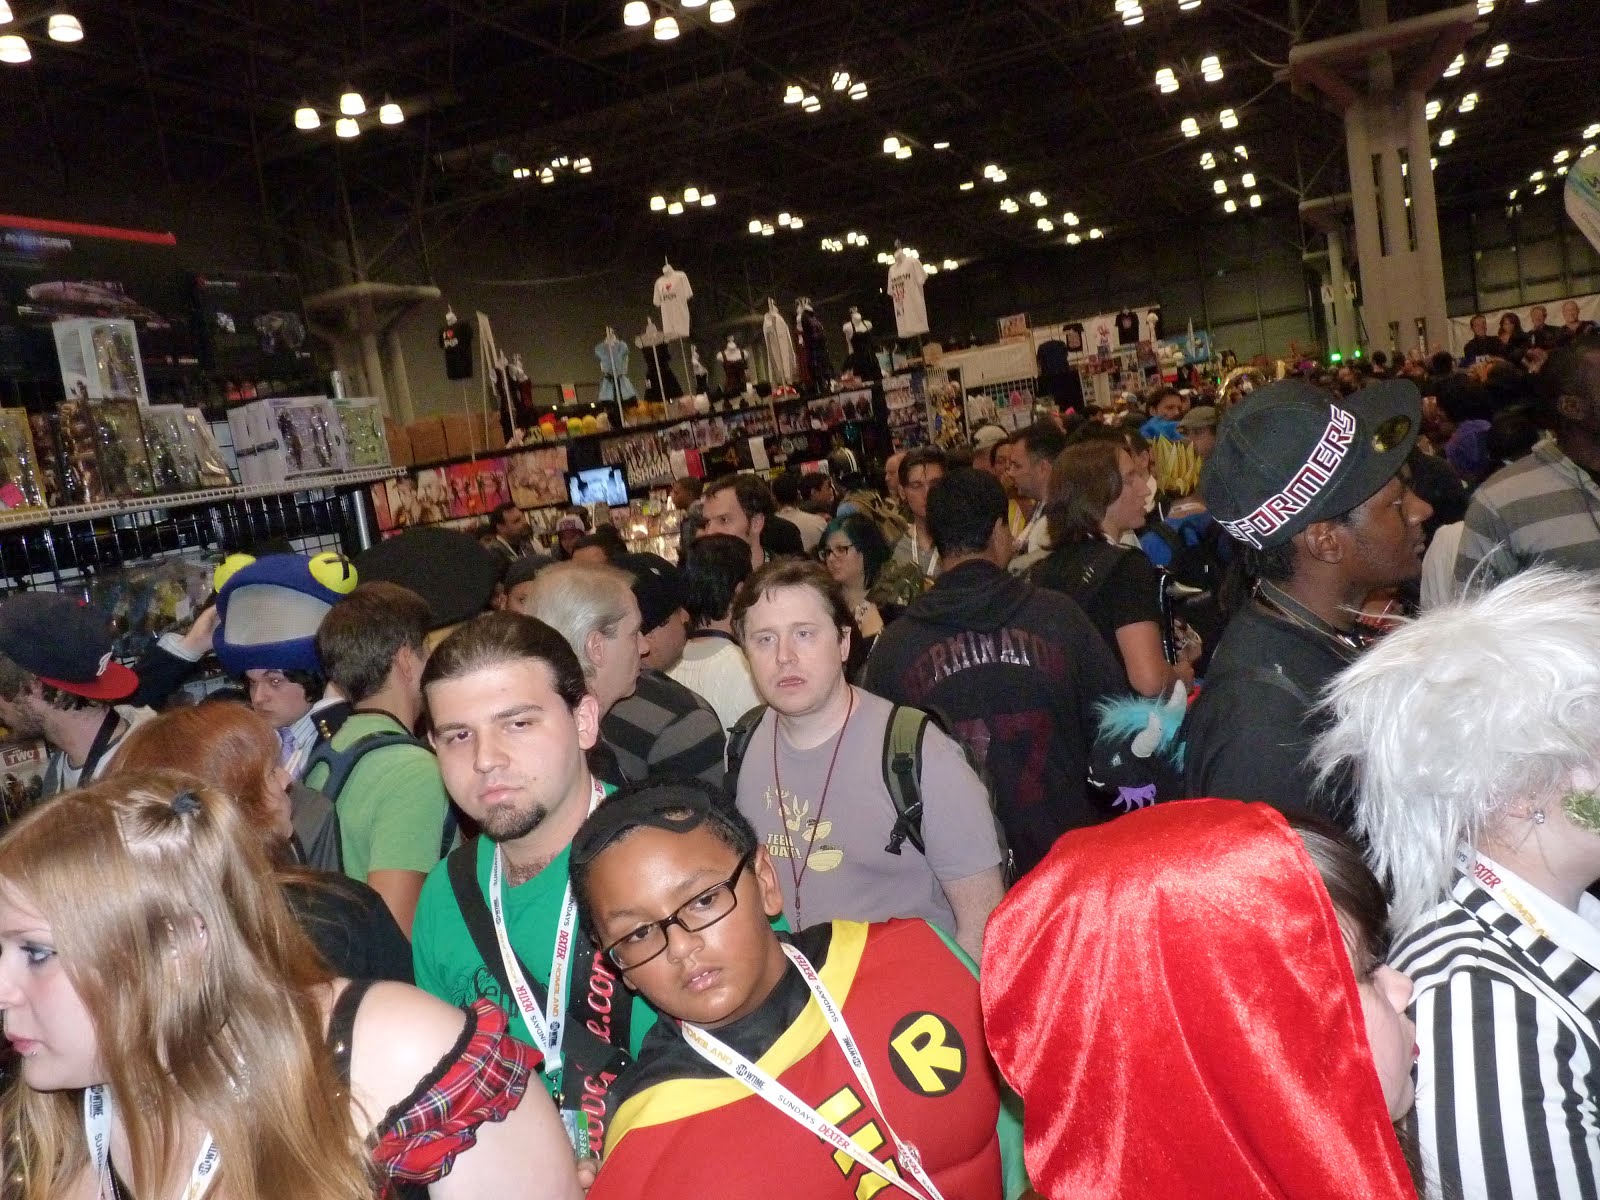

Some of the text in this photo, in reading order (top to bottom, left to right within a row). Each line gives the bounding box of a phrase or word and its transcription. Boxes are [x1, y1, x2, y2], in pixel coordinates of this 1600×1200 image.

[8, 749, 34, 764] TWO
[767, 833, 794, 847] TEEN
[767, 844, 802, 859] OAT!
[564, 896, 576, 926] UNDAYS
[556, 930, 569, 960] DEXTER
[516, 985, 535, 1013] DEXTER
[553, 963, 563, 1018] HOMELAND
[793, 954, 818, 981] DEXTER
[815, 985, 839, 1023] SUNDAYS
[890, 1013, 962, 1092] R
[92, 1085, 104, 1117] OWTIME
[683, 1022, 733, 1067] HOMELAND
[778, 1094, 816, 1125] SUNDAYS
[818, 1123, 851, 1150] DEXTER
